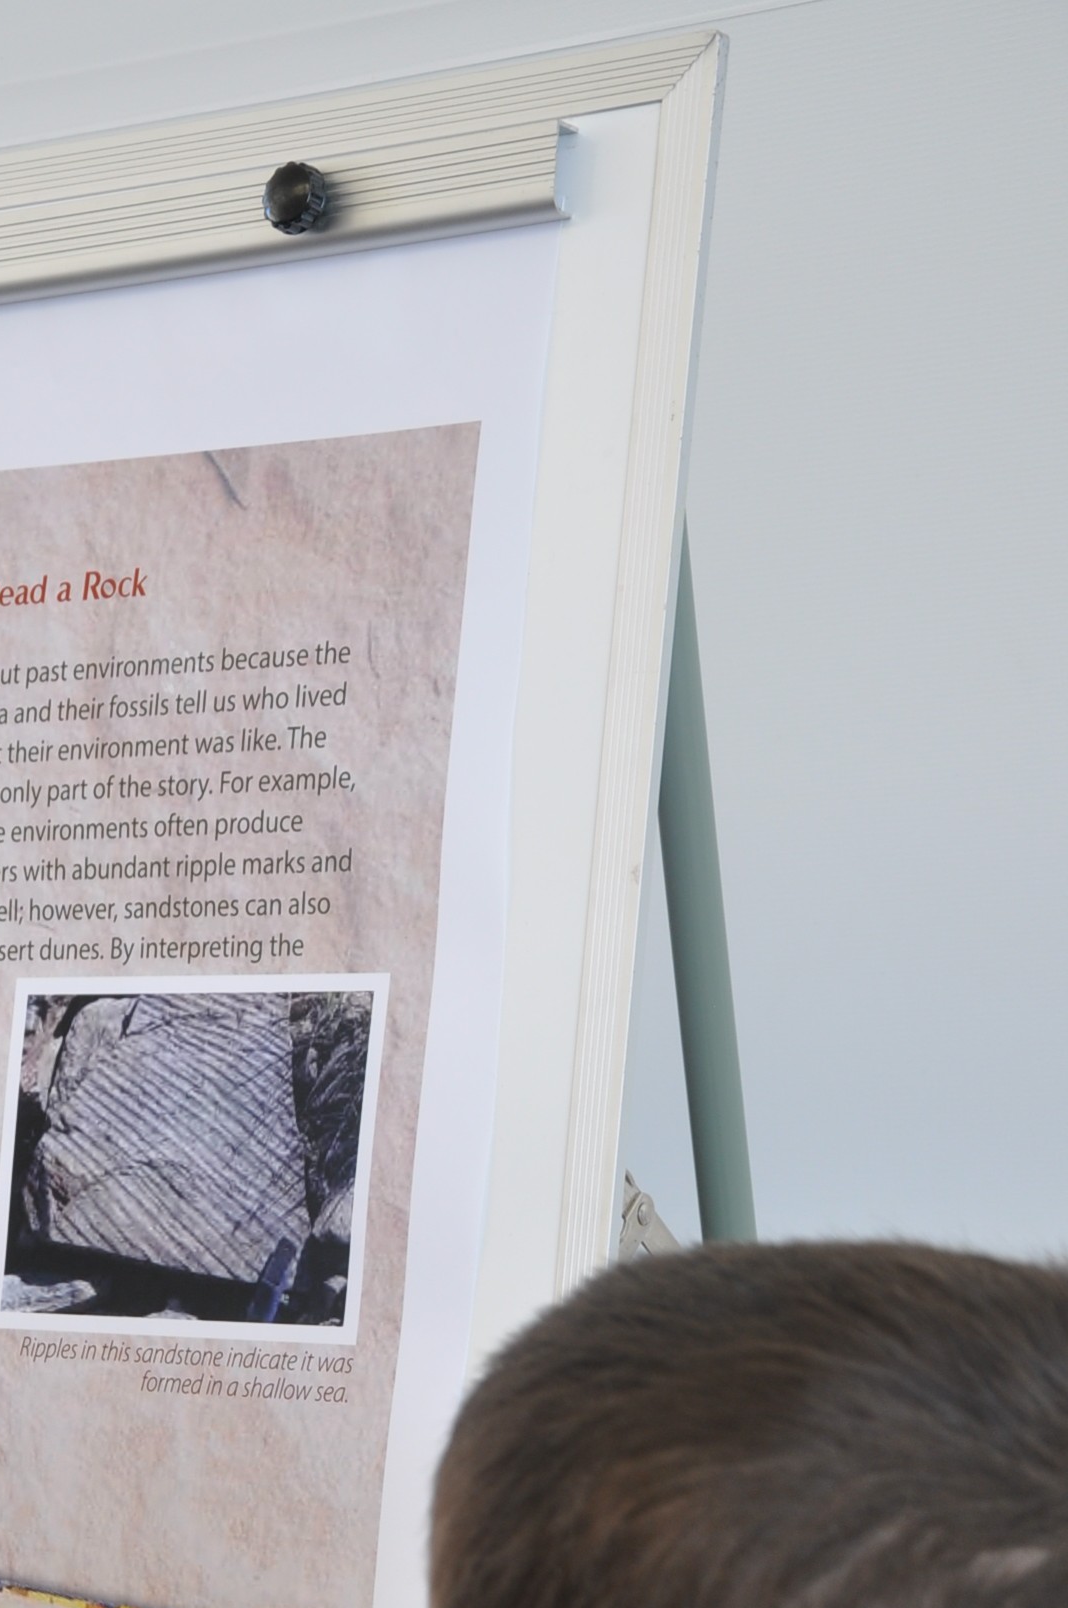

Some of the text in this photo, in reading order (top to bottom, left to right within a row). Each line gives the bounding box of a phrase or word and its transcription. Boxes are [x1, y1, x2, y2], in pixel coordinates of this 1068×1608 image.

[56, 581, 72, 603] a
[82, 567, 148, 601] Rock
[25, 660, 69, 690] past
[73, 651, 215, 681] environments
[220, 646, 309, 672] because
[314, 640, 351, 666] the
[13, 698, 52, 725] and
[57, 697, 105, 722] their
[109, 692, 169, 719] fossils
[175, 689, 208, 716] tell
[213, 694, 236, 713] us
[242, 685, 290, 711] who
[295, 680, 348, 708] lived
[7, 739, 54, 764] their
[57, 734, 190, 762] environment
[194, 735, 235, 755] was
[240, 727, 282, 753] like.
[286, 724, 327, 750] The
[0, 778, 43, 809] only
[46, 779, 88, 808] part
[92, 774, 116, 800] of
[118, 774, 152, 799] the
[157, 775, 213, 802] story.
[219, 770, 254, 795] For
[258, 764, 356, 797] example,
[10, 817, 149, 843] environments
[153, 812, 209, 838] often
[214, 809, 304, 842] produce
[22, 857, 66, 882] with
[71, 854, 171, 881] abundant
[176, 851, 236, 883] ripple
[242, 849, 306, 876] marks
[311, 847, 353, 874] and
[29, 897, 118, 923] however,
[123, 894, 240, 920] sandstones
[245, 898, 282, 917] can
[288, 890, 331, 916] also
[39, 937, 104, 961] dunes.
[110, 936, 135, 966] By
[139, 934, 263, 965] interpreting
[269, 932, 305, 958] the
[19, 1335, 354, 1374] Ripples in this sandstone indicate it was
[140, 1369, 348, 1404] formed in a shallow sea.
